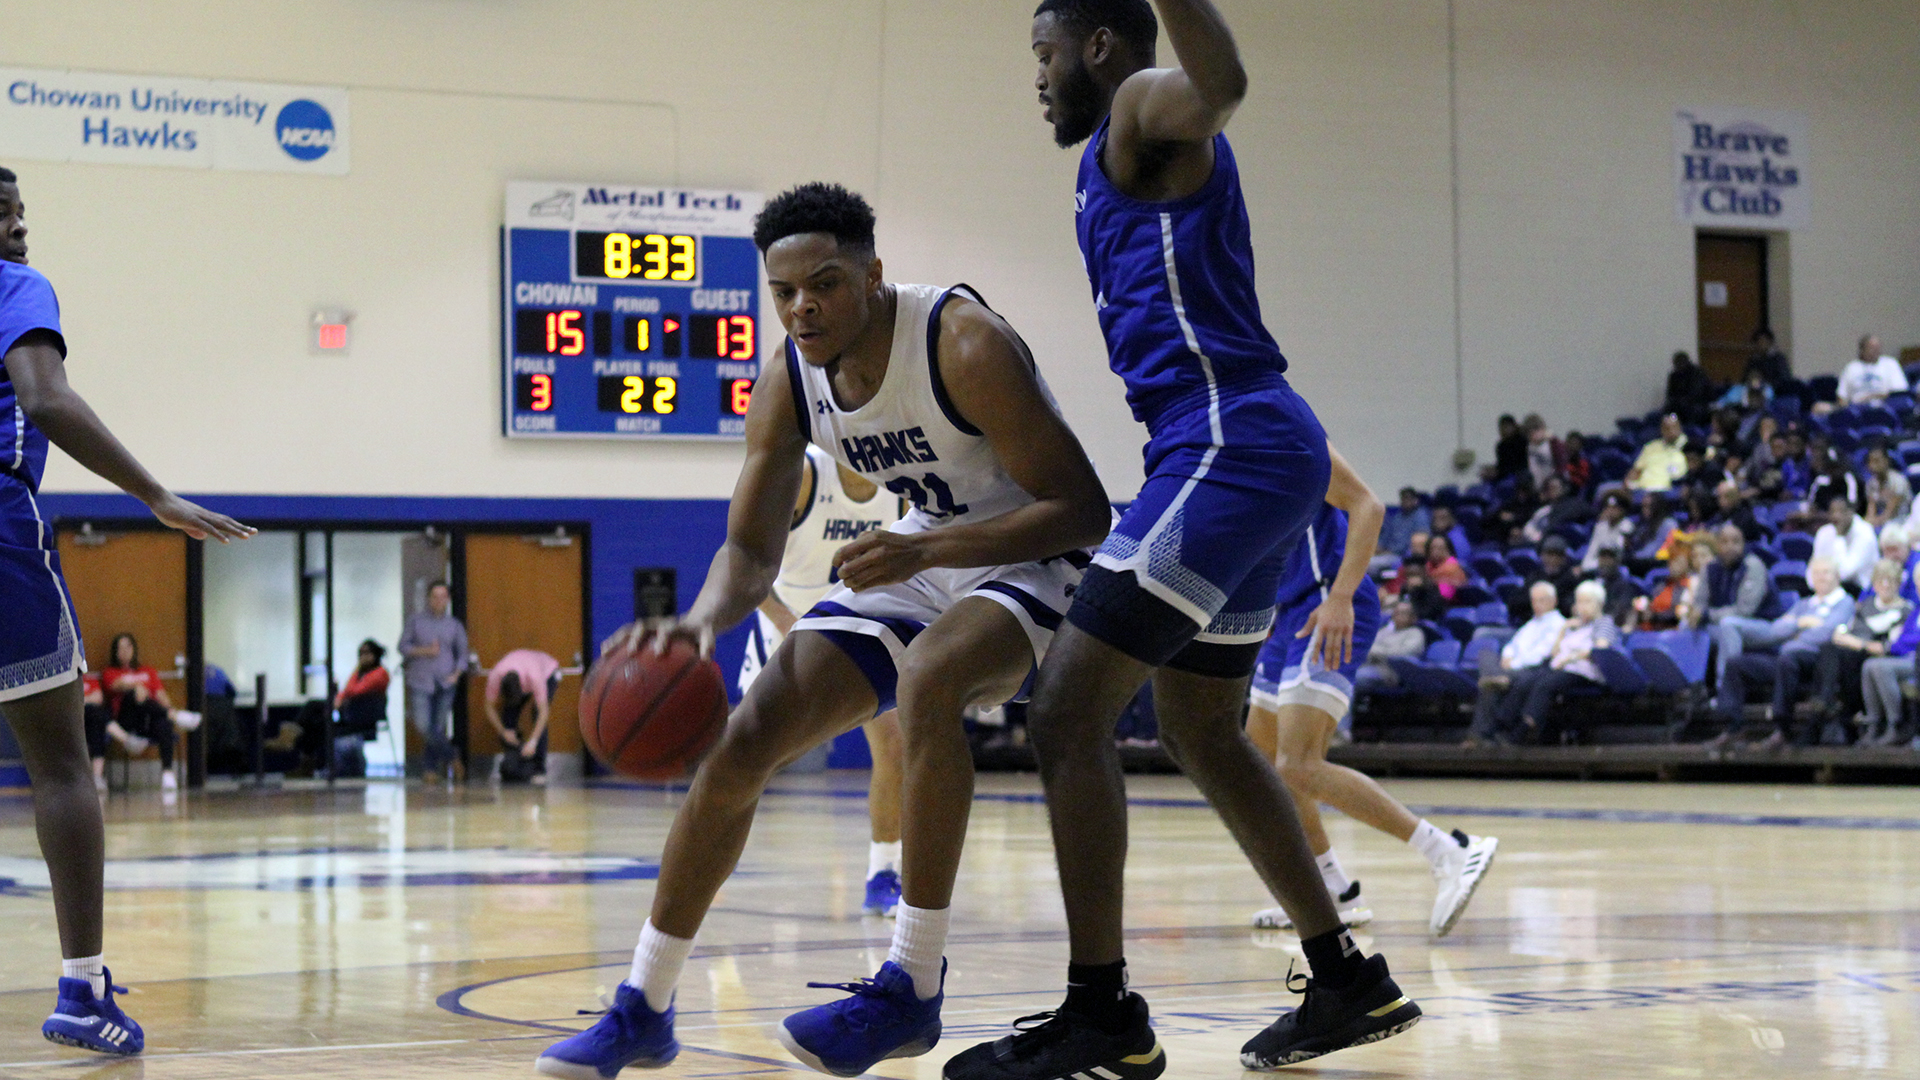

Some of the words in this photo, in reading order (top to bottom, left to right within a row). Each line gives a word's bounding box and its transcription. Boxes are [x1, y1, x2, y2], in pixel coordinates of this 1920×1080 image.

[8, 80, 121, 111] Chowan
[131, 88, 268, 125] University
[82, 117, 198, 151] Hawks
[280, 126, 336, 148] NCAA
[1692, 122, 1789, 156] Brave
[1683, 154, 1798, 187] Hawks
[582, 188, 665, 207] Metal
[671, 190, 741, 211] Tech
[1700, 185, 1782, 218] Club
[603, 232, 696, 281] 8:33
[515, 282, 598, 306] CHOWAN
[613, 296, 661, 314] PERIOD
[691, 288, 751, 311] GUEST
[545, 310, 585, 356] 15
[637, 319, 650, 351] 1
[716, 315, 755, 361] 13
[514, 357, 556, 375] FOULS
[593, 359, 643, 377] PLAYER
[647, 361, 681, 378] FOUL
[716, 363, 758, 379] FOULS
[530, 373, 553, 412] 3
[620, 375, 677, 414] 22
[730, 378, 753, 416] 6
[515, 415, 556, 431] SCORE
[718, 419, 747, 434] SCO
[841, 425, 940, 473] HAWKS
